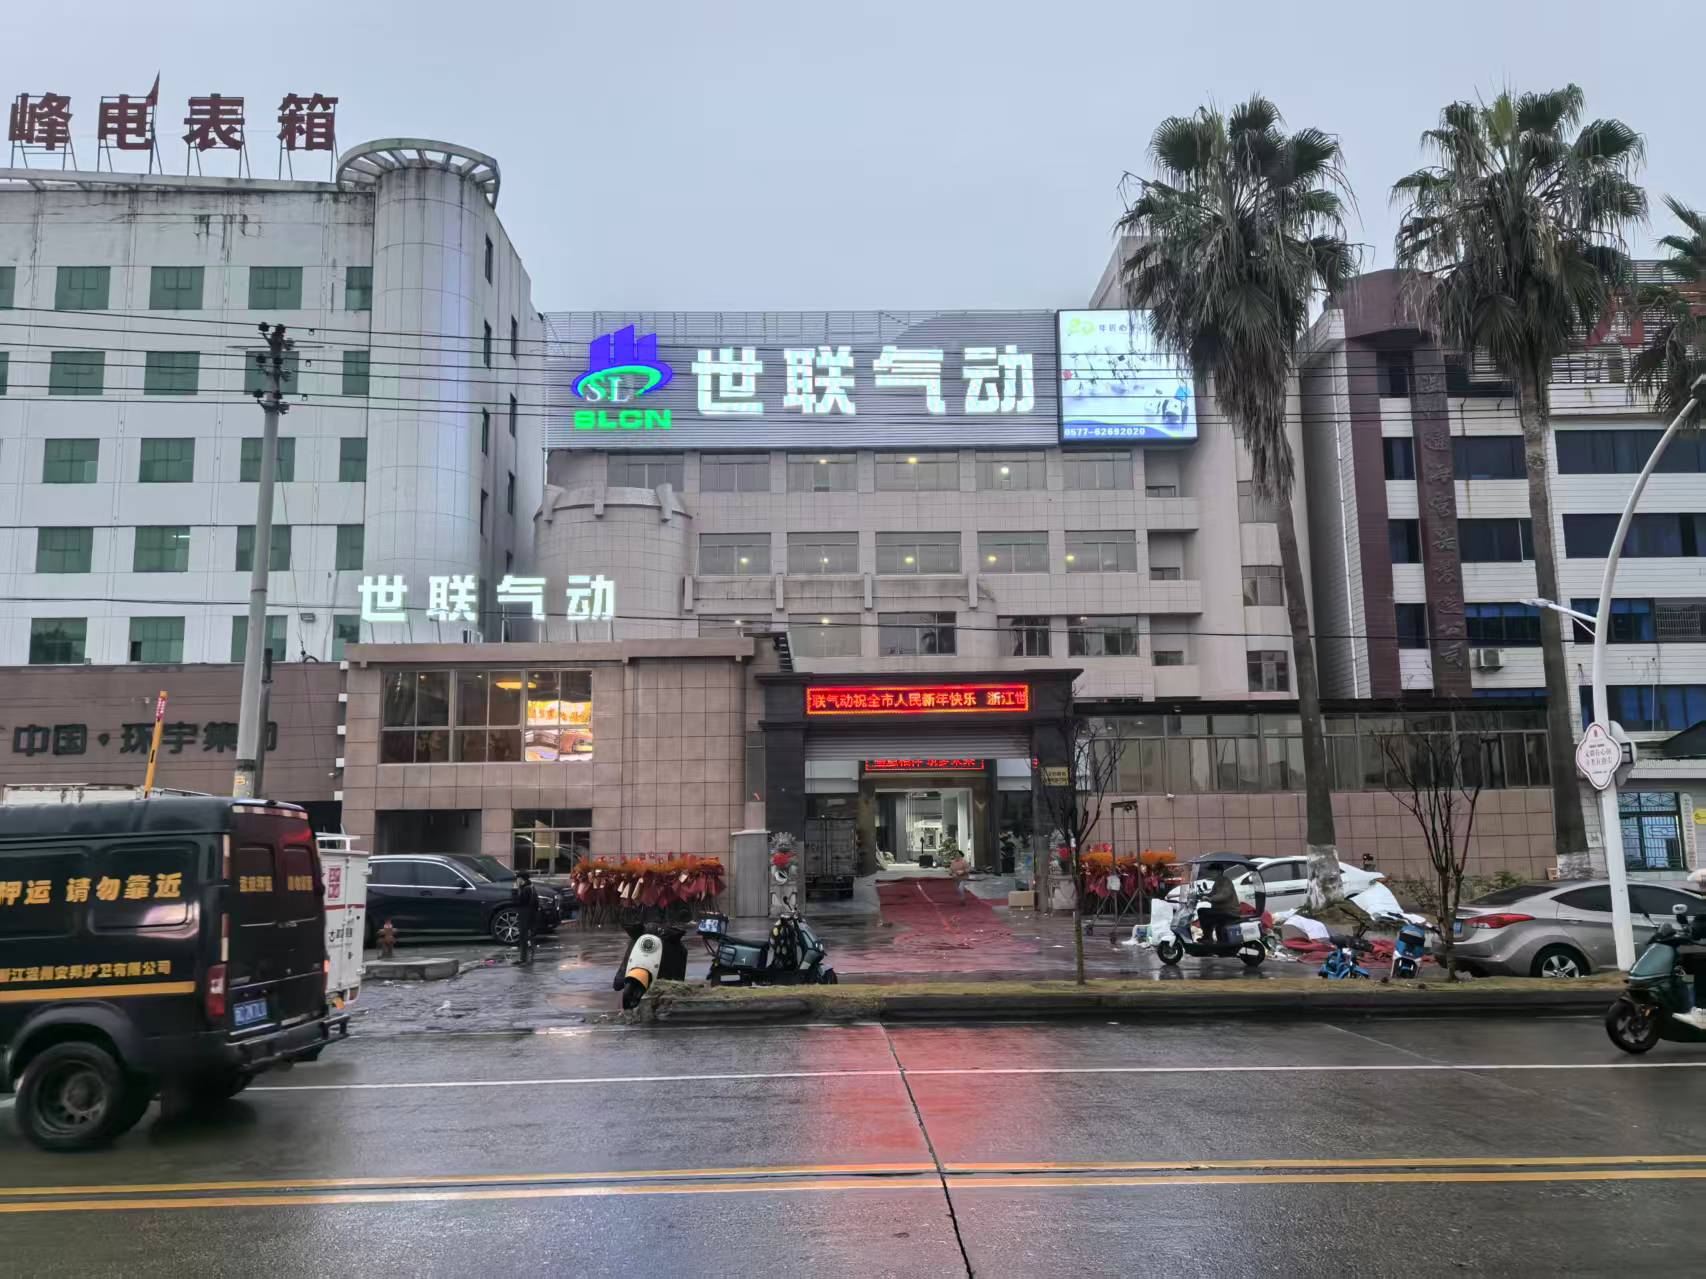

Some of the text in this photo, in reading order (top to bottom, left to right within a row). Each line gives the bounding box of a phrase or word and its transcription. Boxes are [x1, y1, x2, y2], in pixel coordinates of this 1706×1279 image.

[9, 92, 338, 151] 峰电表箱
[692, 345, 1035, 415] 世联气动
[358, 575, 615, 621] 世联气动
[812, 692, 977, 709] 联气动祝全市人民新年快乐
[65, 872, 183, 902] 请勿靠近
